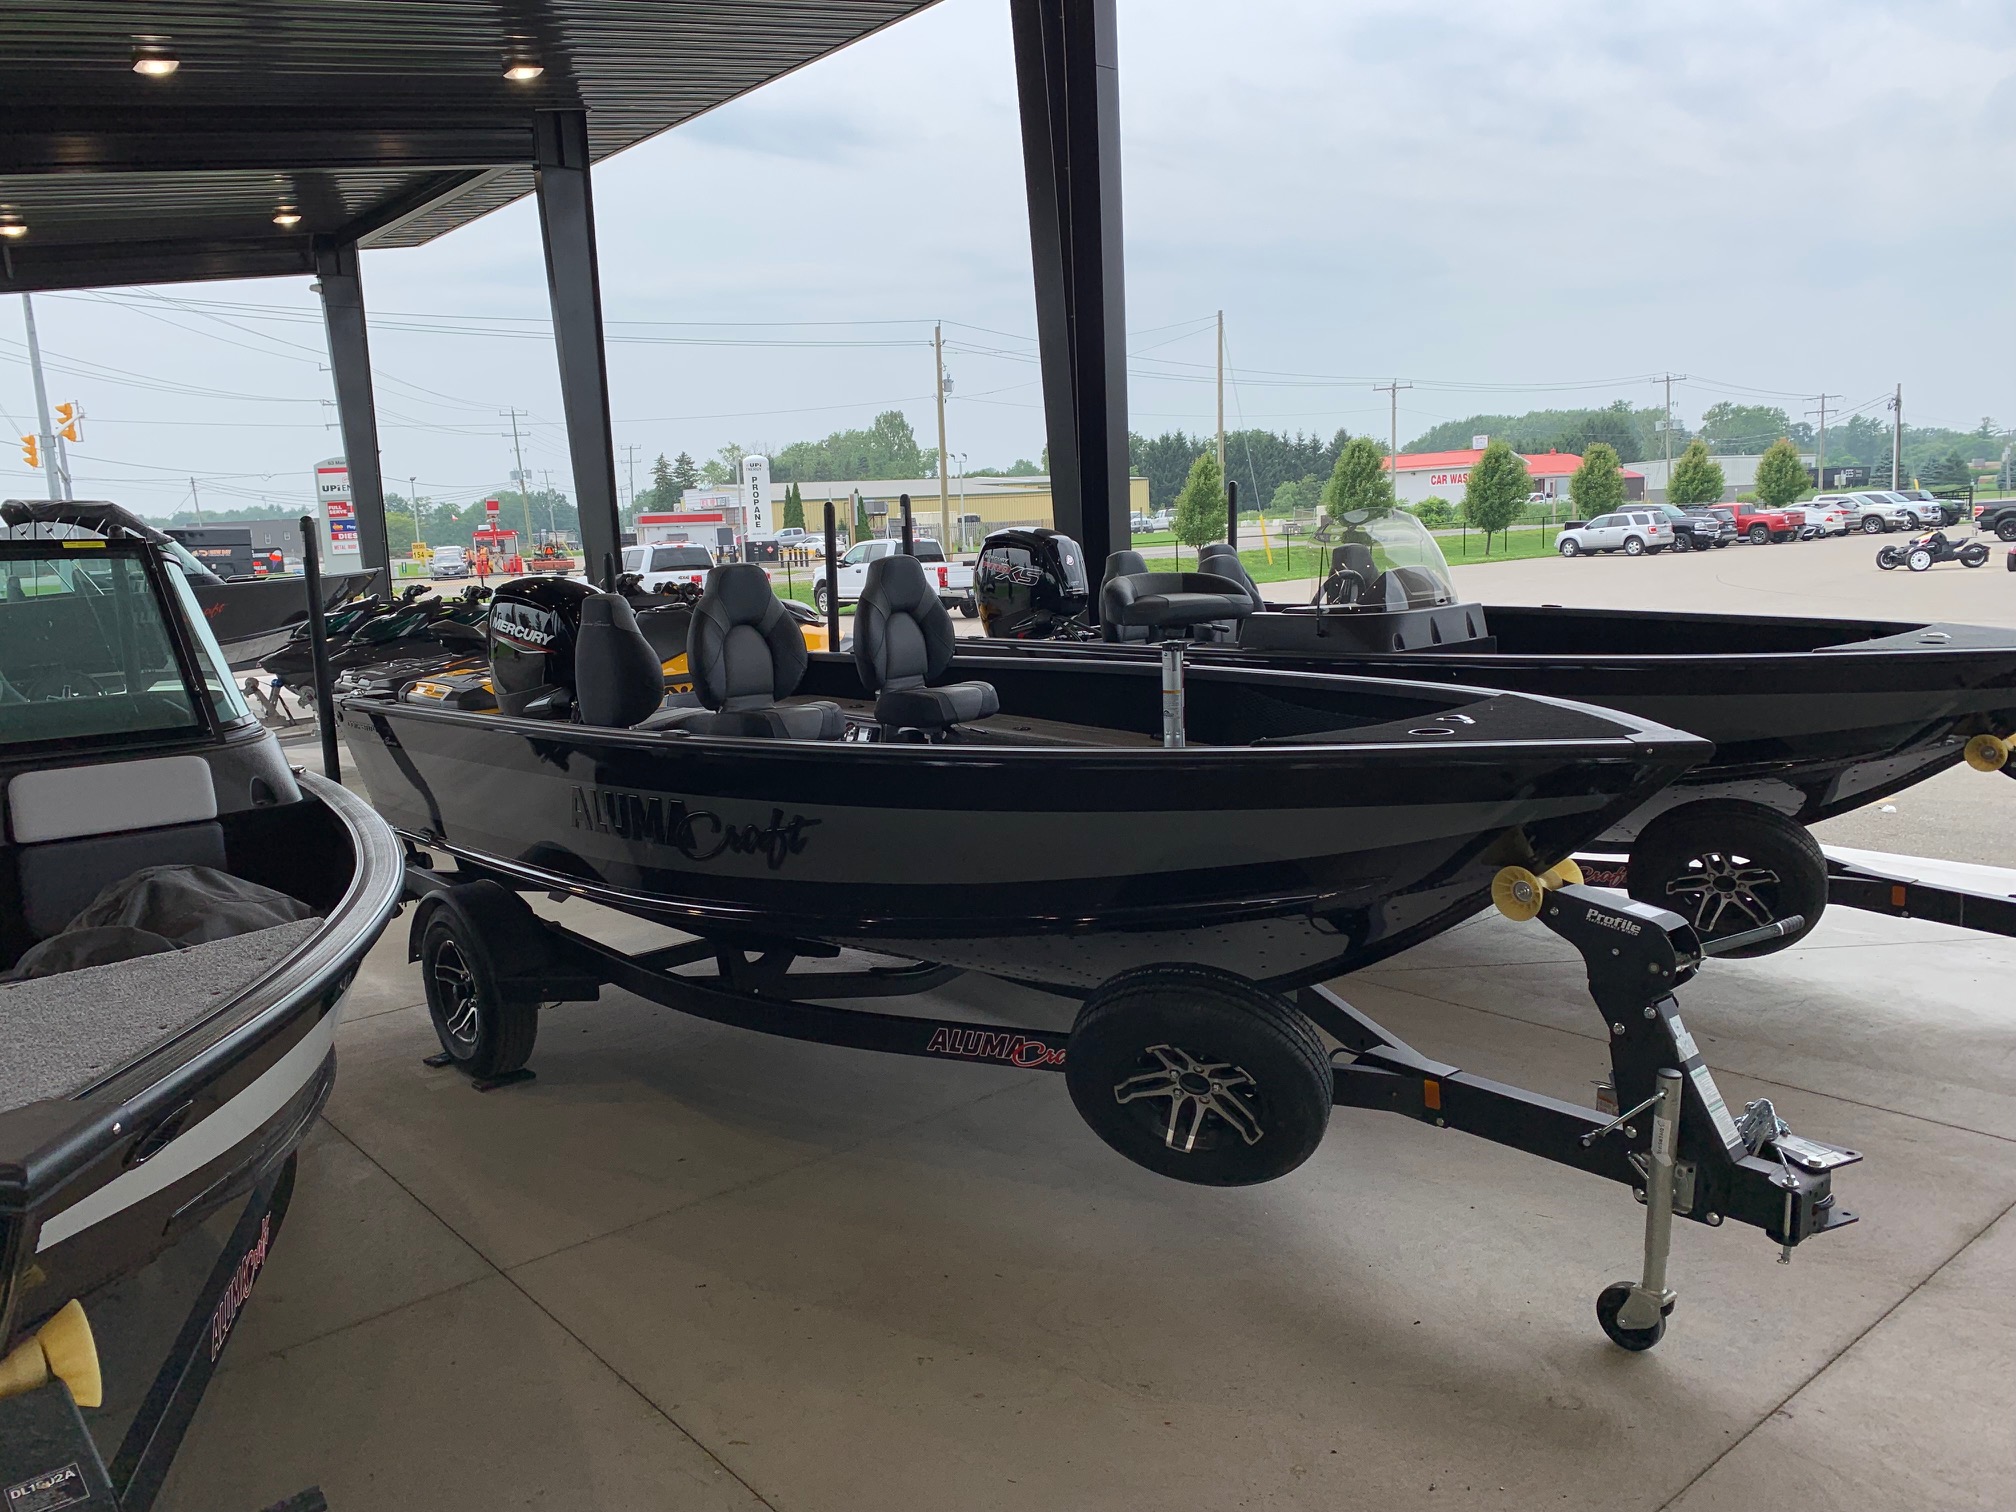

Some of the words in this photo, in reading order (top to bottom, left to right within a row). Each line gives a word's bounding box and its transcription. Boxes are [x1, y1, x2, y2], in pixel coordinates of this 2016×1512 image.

[1431, 474, 1448, 485] CAR
[751, 476, 761, 528] PROPANE
[491, 616, 556, 646] MERCURY
[1586, 908, 1642, 932] Profile
